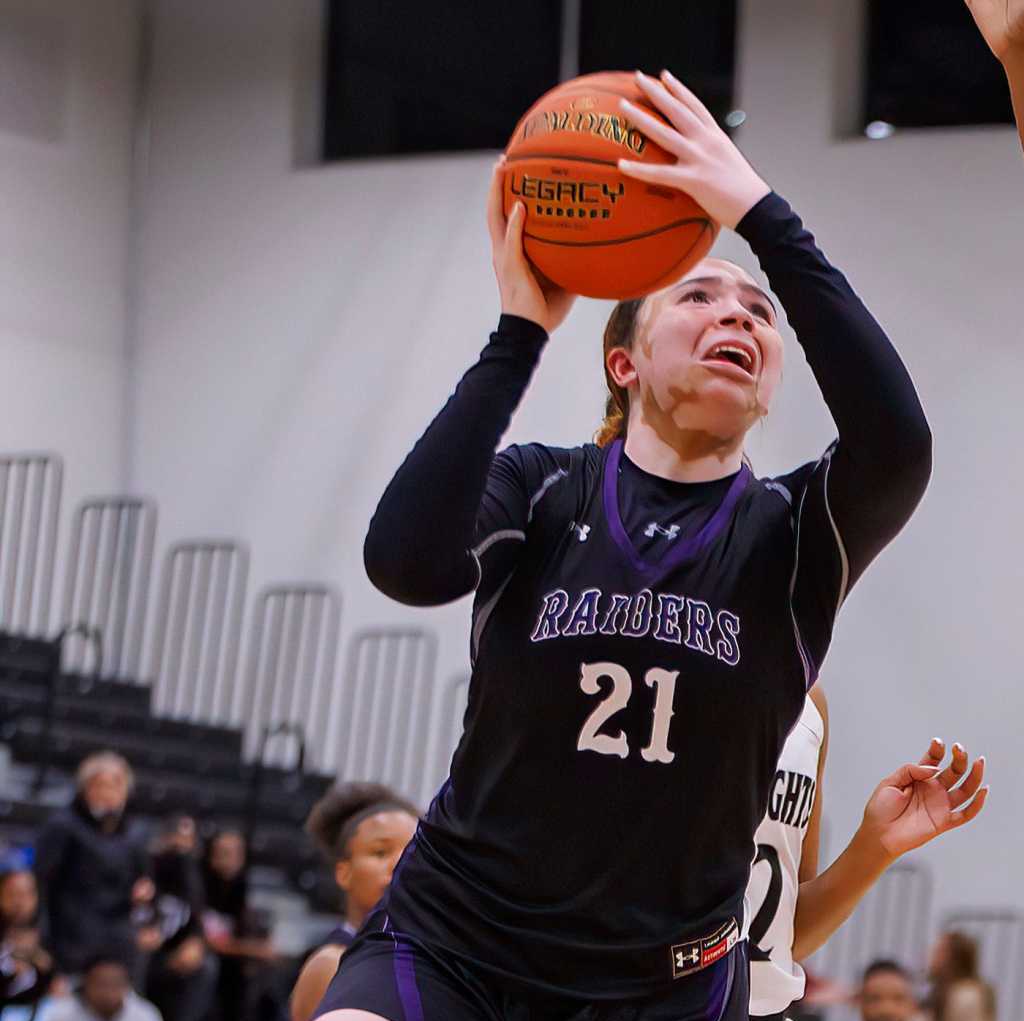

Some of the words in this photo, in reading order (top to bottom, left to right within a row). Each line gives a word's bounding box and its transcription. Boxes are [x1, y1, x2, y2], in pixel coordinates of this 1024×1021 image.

[511, 172, 625, 204] LEGACY
[531, 589, 741, 666] RAIDERS
[577, 661, 680, 764] 21
